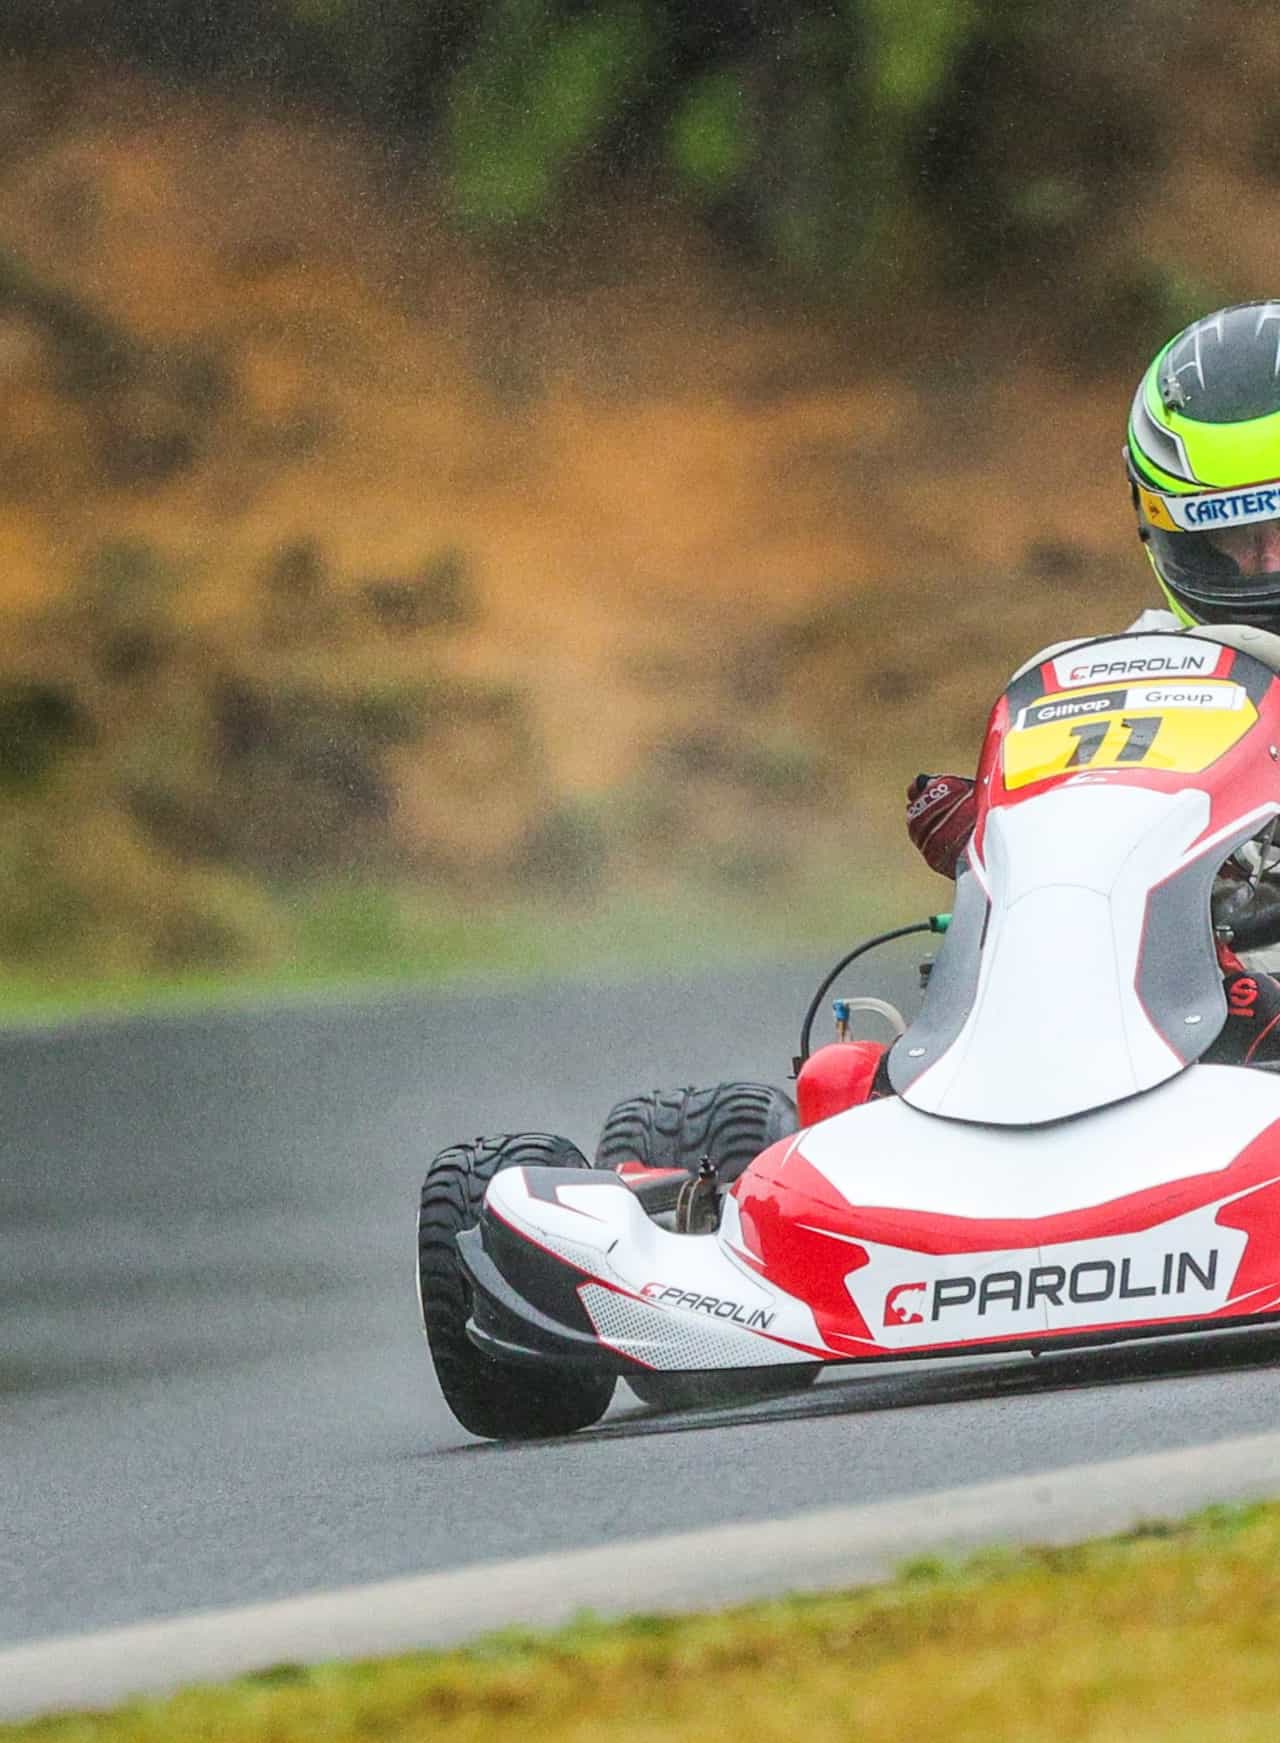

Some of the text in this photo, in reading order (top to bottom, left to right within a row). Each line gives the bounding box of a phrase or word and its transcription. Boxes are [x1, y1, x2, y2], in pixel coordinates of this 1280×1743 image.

[1089, 656, 1206, 679] PAROLIN
[1037, 690, 1214, 720] Giltrap Group
[1064, 716, 1164, 769] 11
[931, 1248, 1219, 1322] PAROLIN
[653, 1287, 776, 1329] PAROLIN
